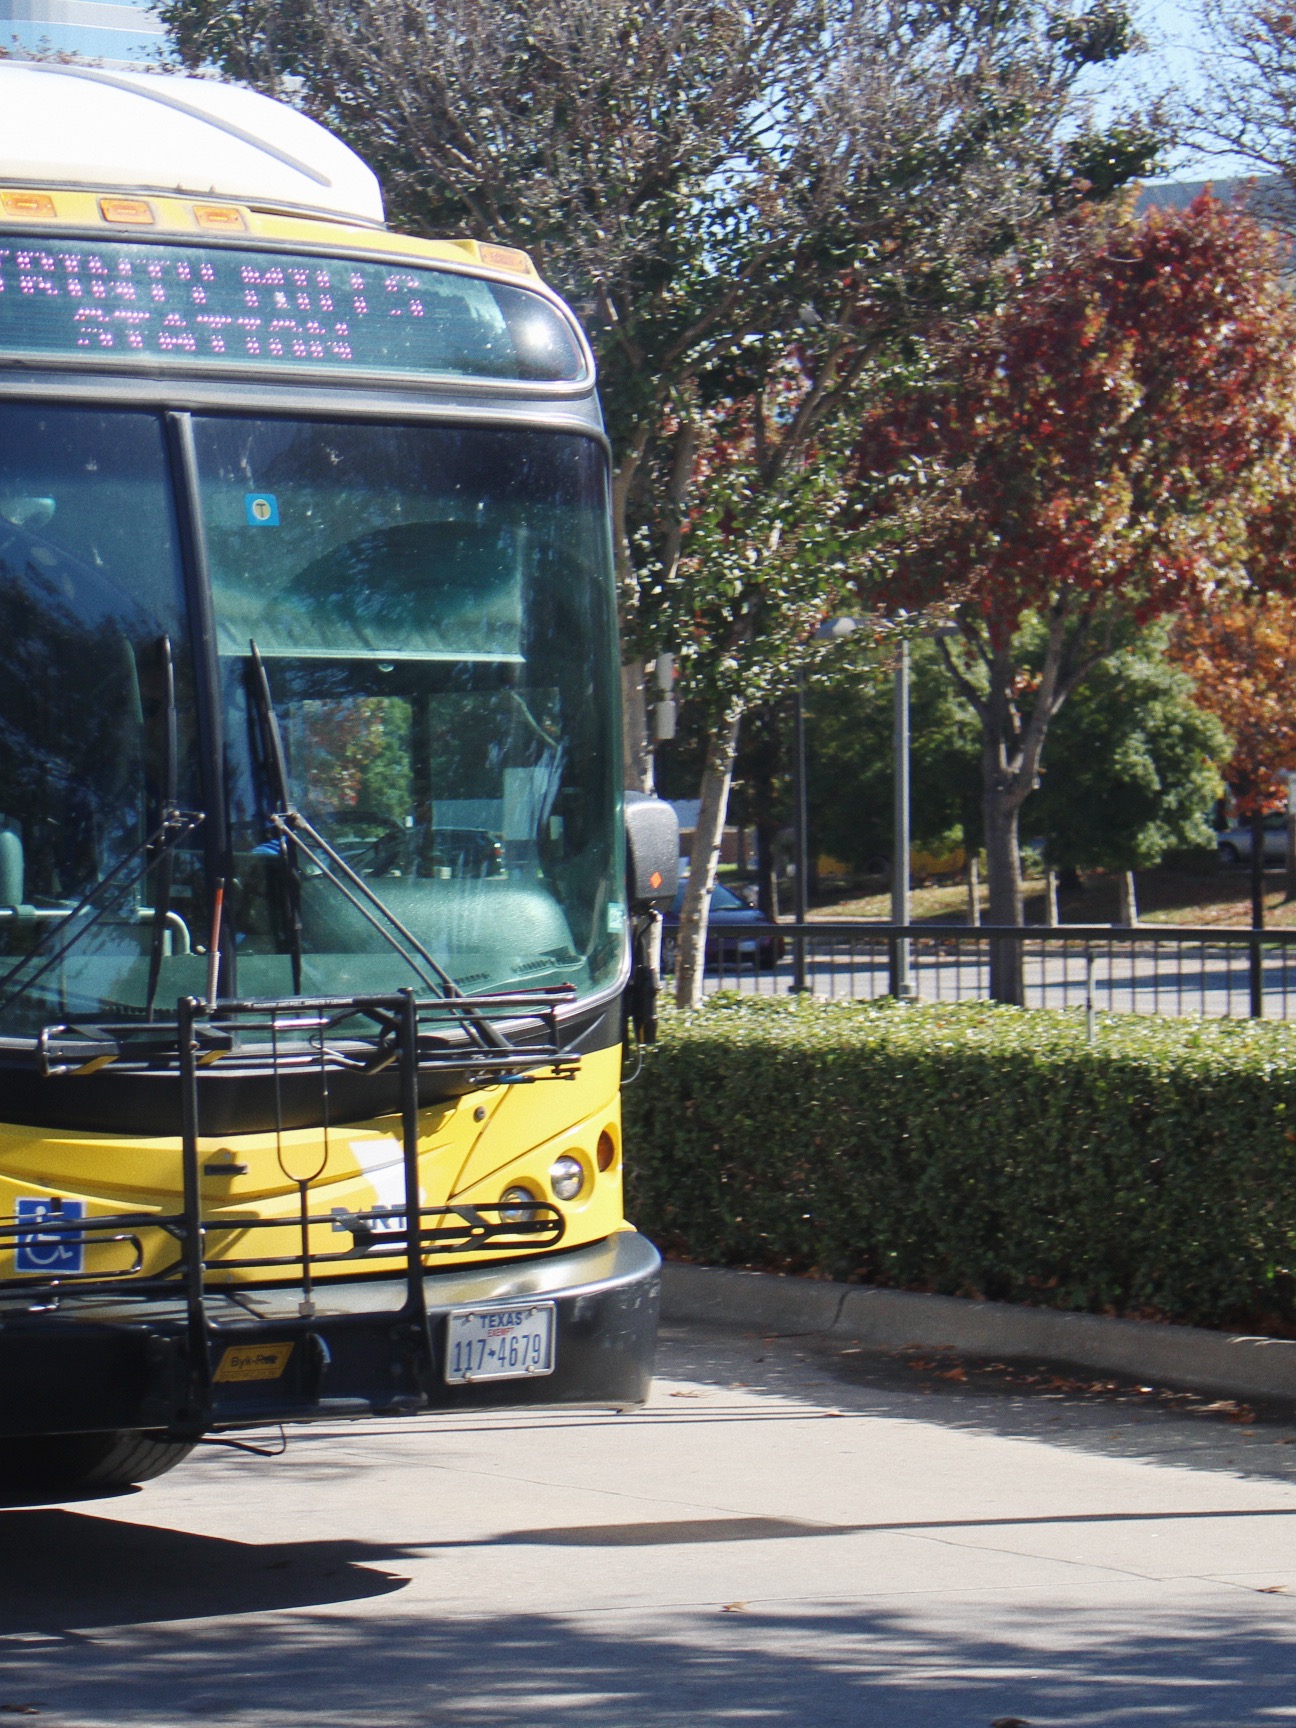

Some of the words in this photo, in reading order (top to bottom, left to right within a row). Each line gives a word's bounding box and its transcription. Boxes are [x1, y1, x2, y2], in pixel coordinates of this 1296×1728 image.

[74, 308, 353, 359] STATION
[331, 1204, 408, 1232] DRT
[480, 1312, 523, 1328] TEXAS
